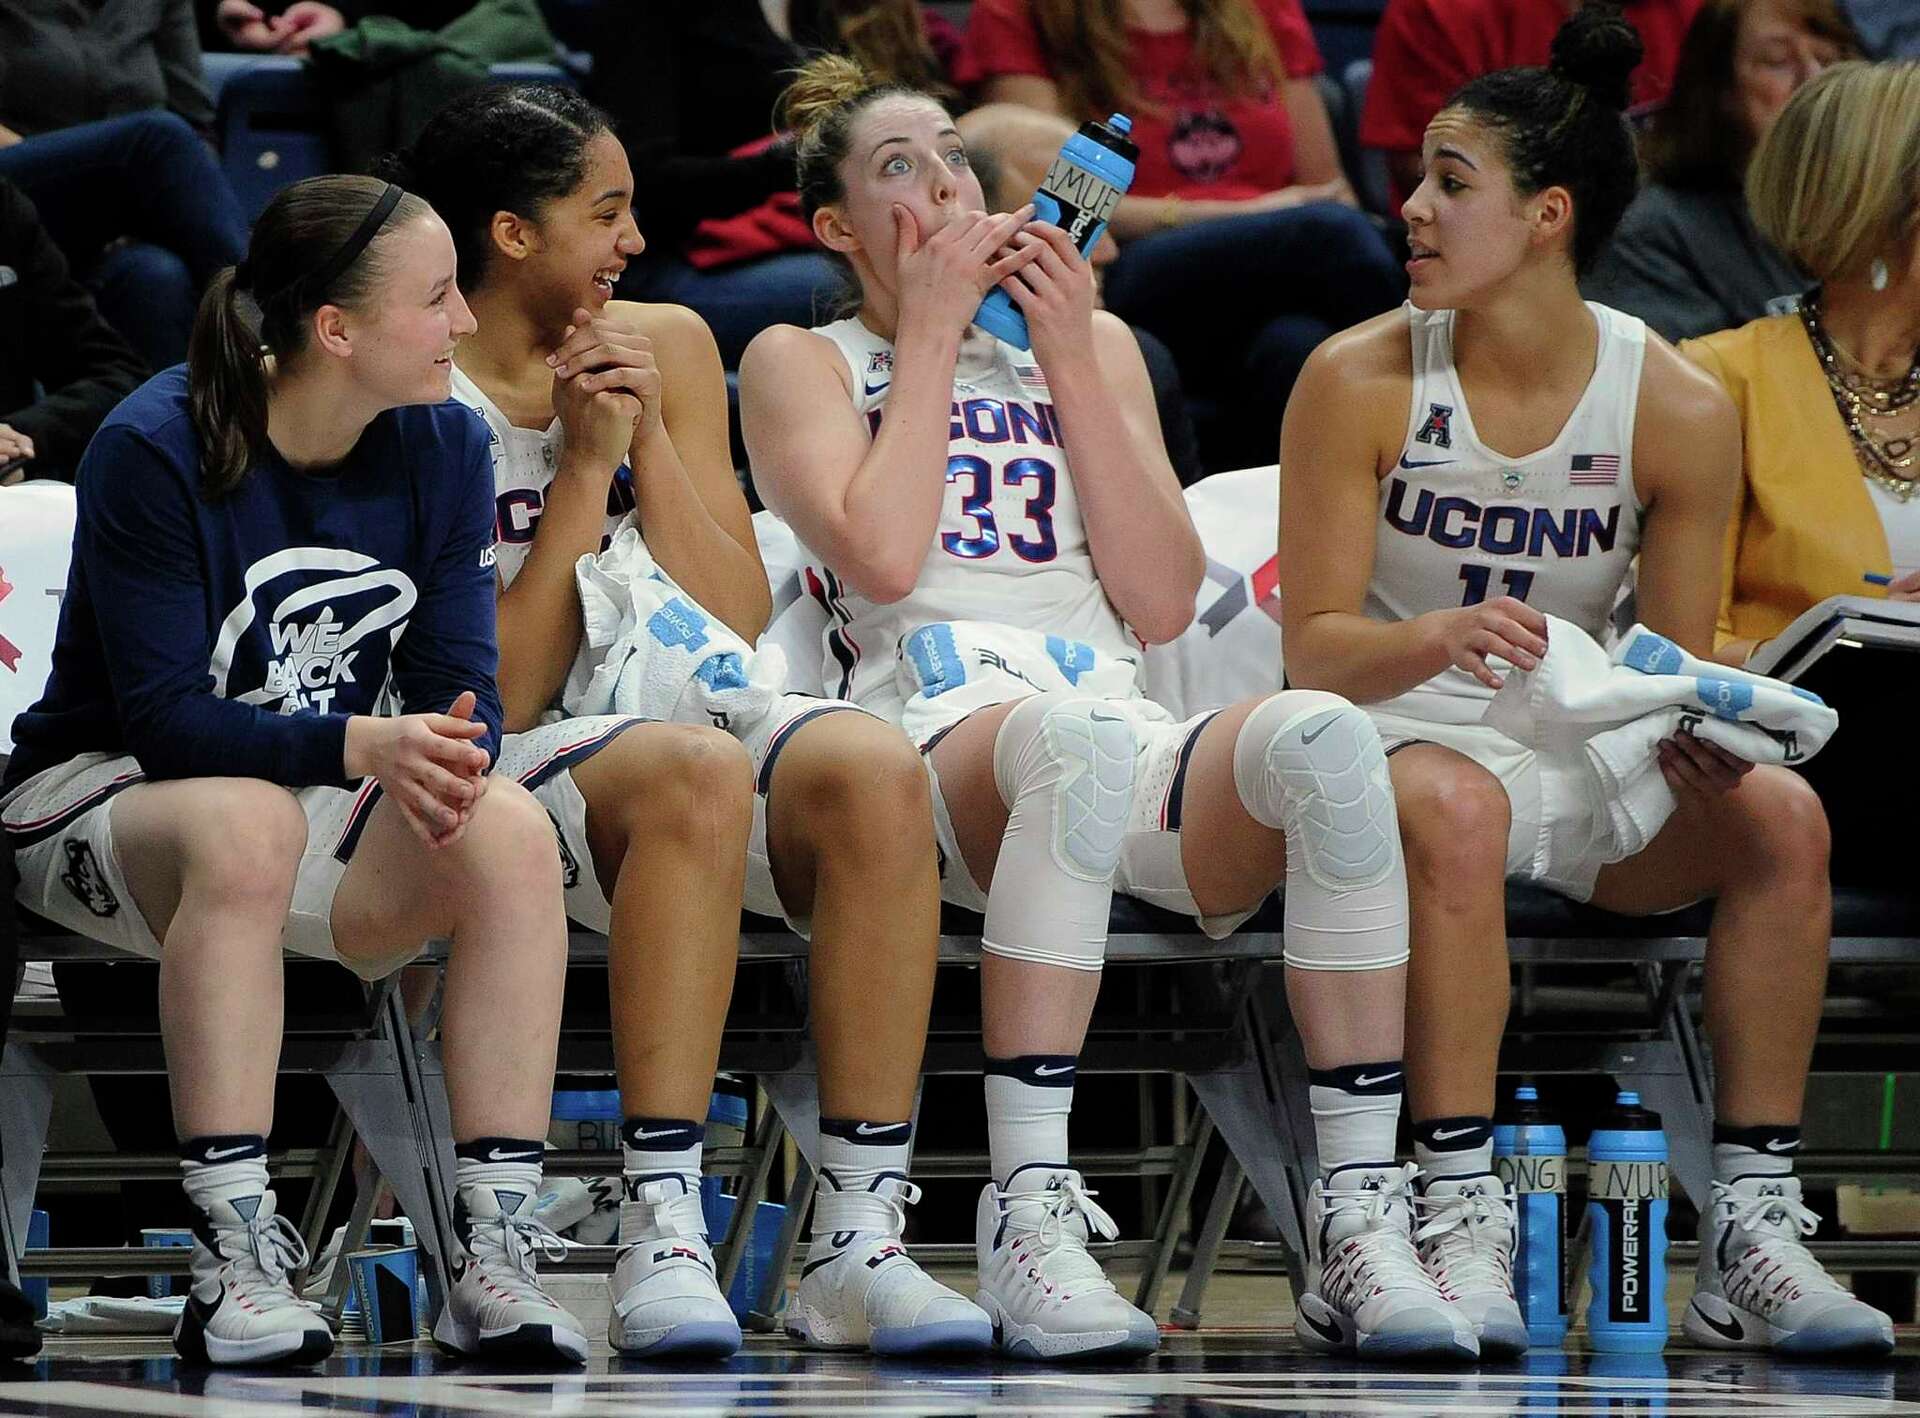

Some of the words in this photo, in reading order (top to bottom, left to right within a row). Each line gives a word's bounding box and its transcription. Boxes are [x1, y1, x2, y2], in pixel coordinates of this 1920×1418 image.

[941, 455, 1058, 563] 33
[1385, 478, 1621, 558] UCONN
[269, 622, 343, 656] WE
[264, 650, 360, 693] BACK
